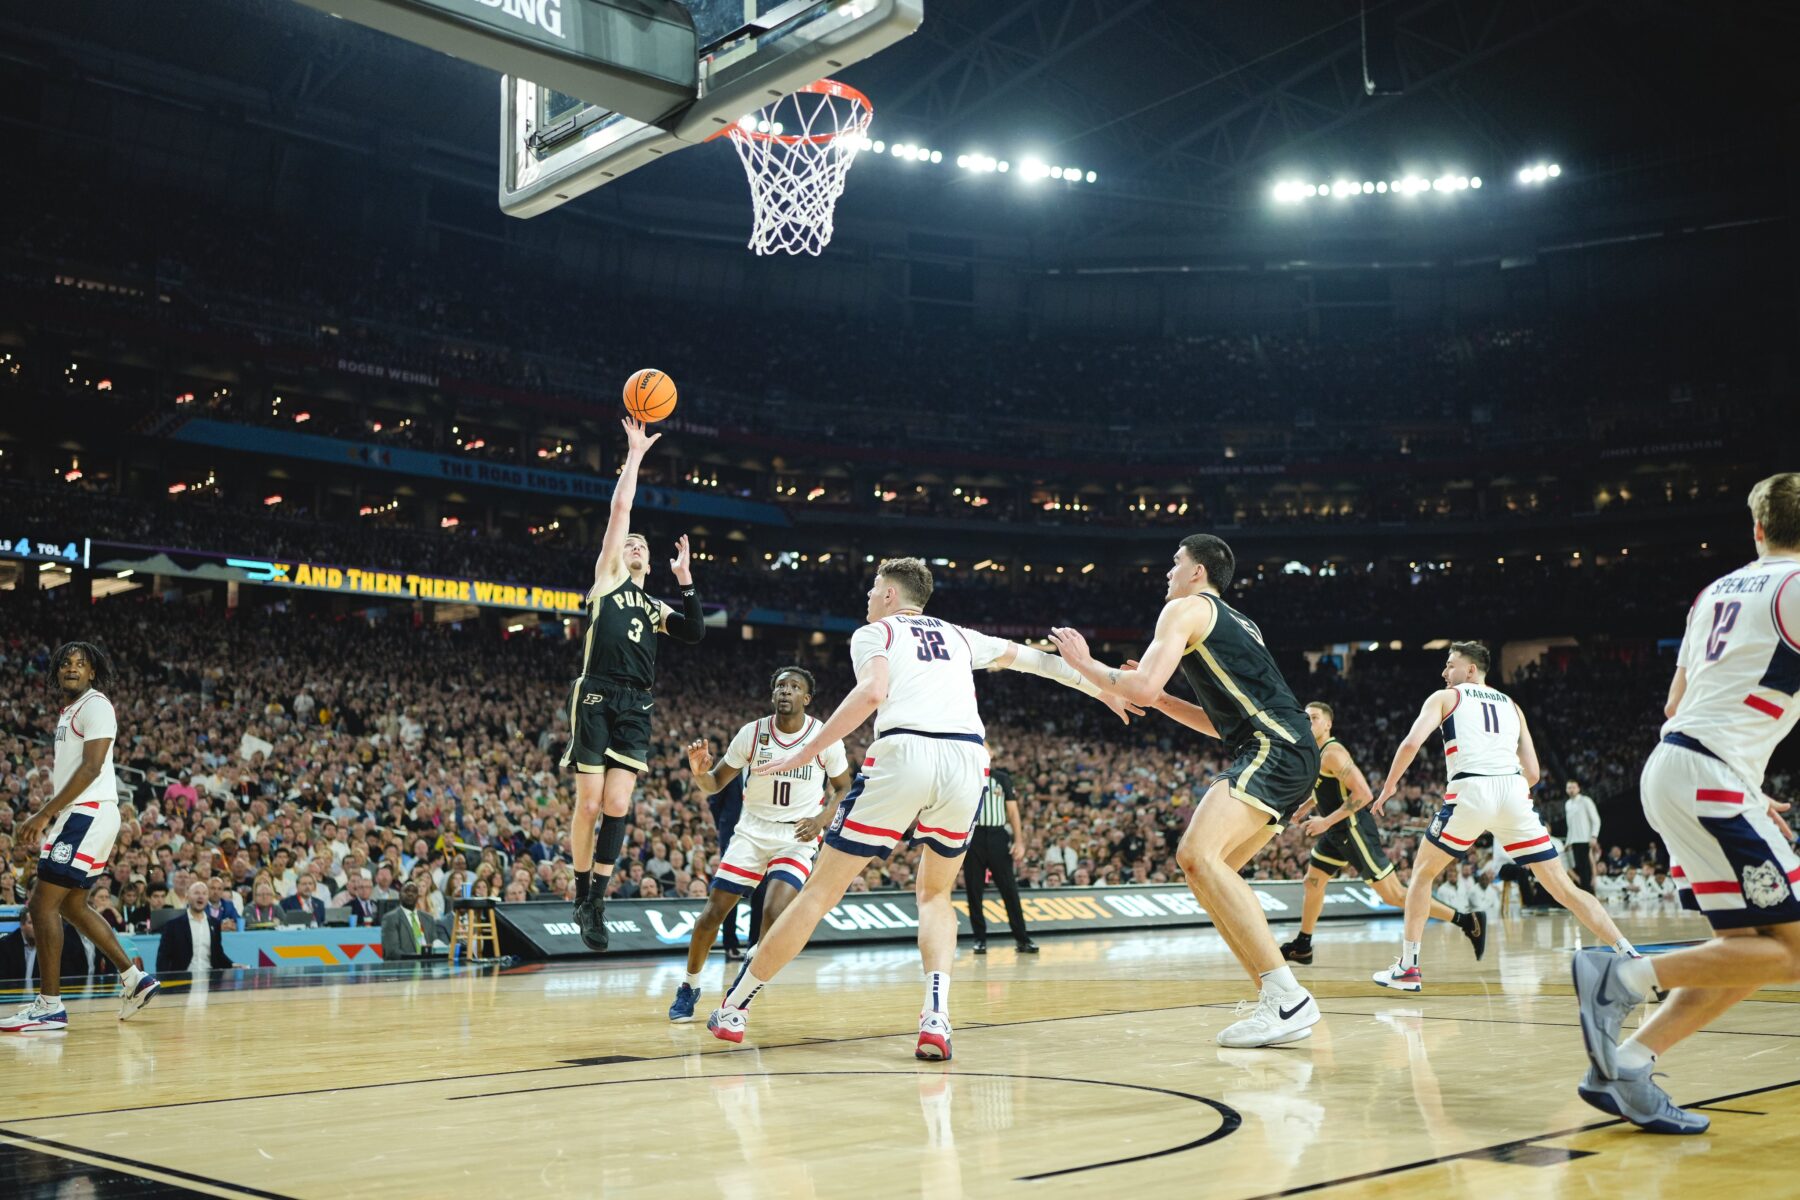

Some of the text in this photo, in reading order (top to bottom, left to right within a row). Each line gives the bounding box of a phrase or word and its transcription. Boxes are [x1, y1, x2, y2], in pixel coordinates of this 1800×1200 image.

[338, 359, 384, 377] ROGER
[388, 368, 439, 387] WEHRLI
[440, 460, 472, 478] THE
[478, 464, 521, 486] ROAD
[527, 473, 567, 492] ENDS
[15, 537, 31, 557] 4
[37, 543, 61, 556] TOL
[63, 542, 79, 561] 4
[295, 563, 582, 611] AND THEN THERE WERE FOUR
[1711, 574, 1771, 595] SPENCER
[628, 617, 644, 643] 3
[910, 626, 951, 662] 32
[1705, 601, 1742, 662] 12
[1481, 701, 1500, 733] 11
[773, 780, 791, 807] 10
[543, 922, 581, 936] DRA
[1103, 894, 1169, 917] ON
